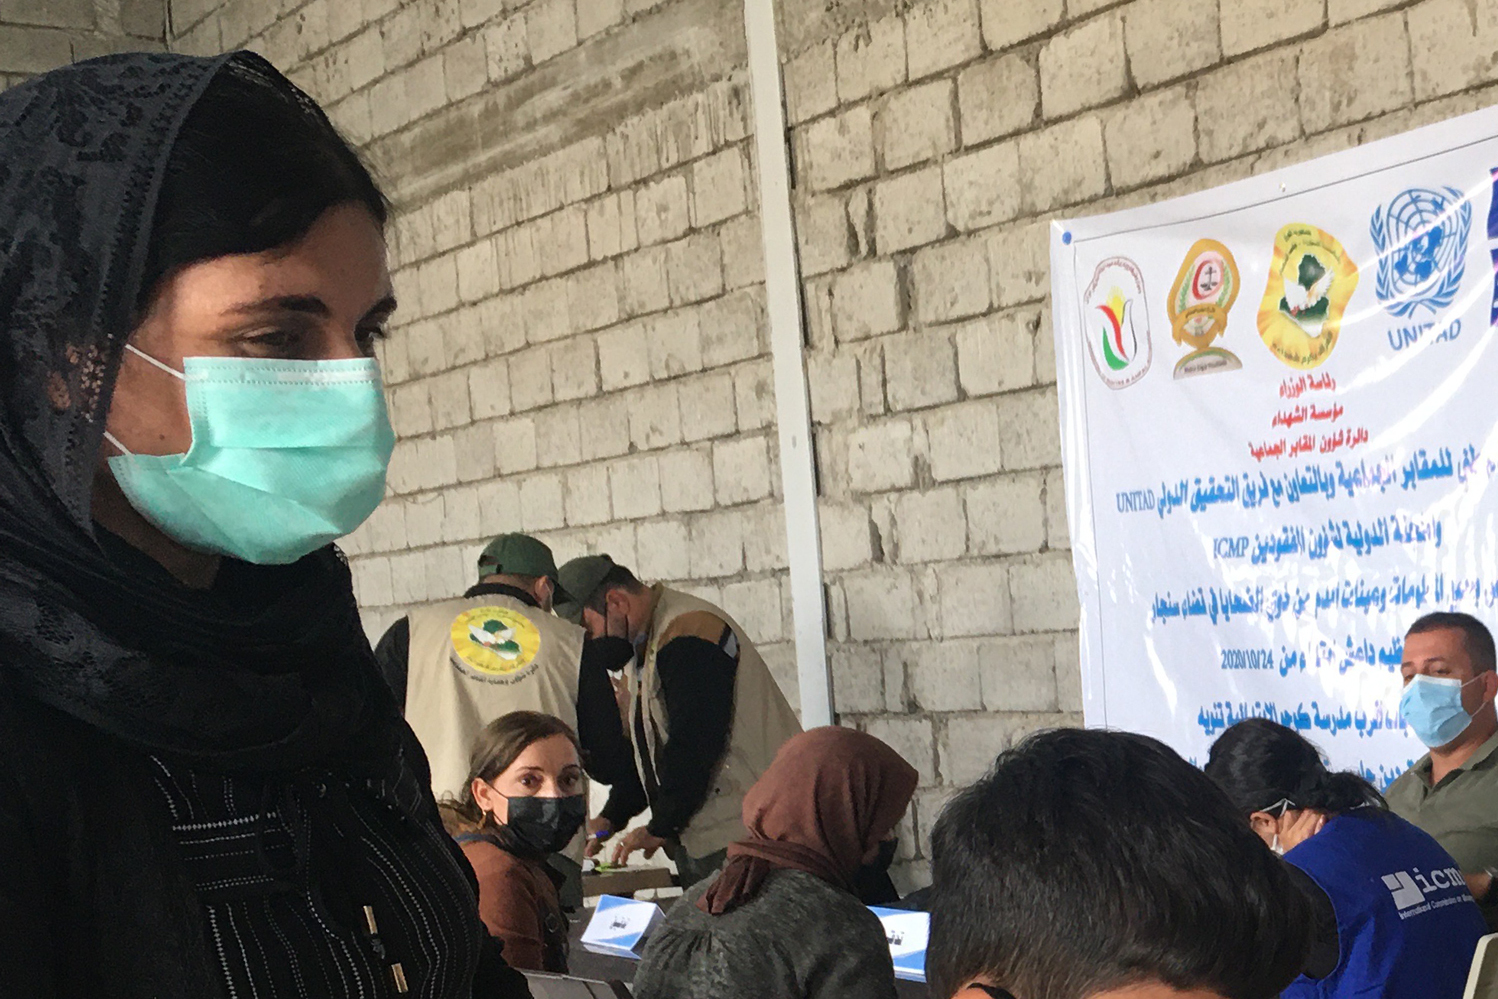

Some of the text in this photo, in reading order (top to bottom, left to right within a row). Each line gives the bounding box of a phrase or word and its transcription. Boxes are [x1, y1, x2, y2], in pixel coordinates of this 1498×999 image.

[1279, 375, 1307, 400] الوزراء
[1271, 401, 1343, 429] مؤسسة الشهداء
[1248, 438, 1286, 463] الجماعية
[1288, 434, 1316, 458] المقابر
[1346, 426, 1369, 450] دائرة
[1285, 464, 1336, 504] وبالتعاون
[1401, 446, 1453, 491] للمقابر
[1116, 488, 1156, 513] UNITAD
[1157, 478, 1189, 520] الدولي
[1190, 474, 1240, 513] التحقيق
[1242, 471, 1269, 509] فريق
[1269, 477, 1284, 509] مع
[1213, 535, 1249, 560] ICMP
[1251, 525, 1305, 565] المفقودين
[1342, 516, 1389, 556] الدولية
[1151, 590, 1181, 625] سنجار
[1220, 648, 1274, 670] 2020/10/24
[1279, 645, 1298, 678] من
[1339, 634, 1376, 676] داعش
[1311, 701, 1352, 737] مدرسة
[1413, 866, 1467, 893] icm
